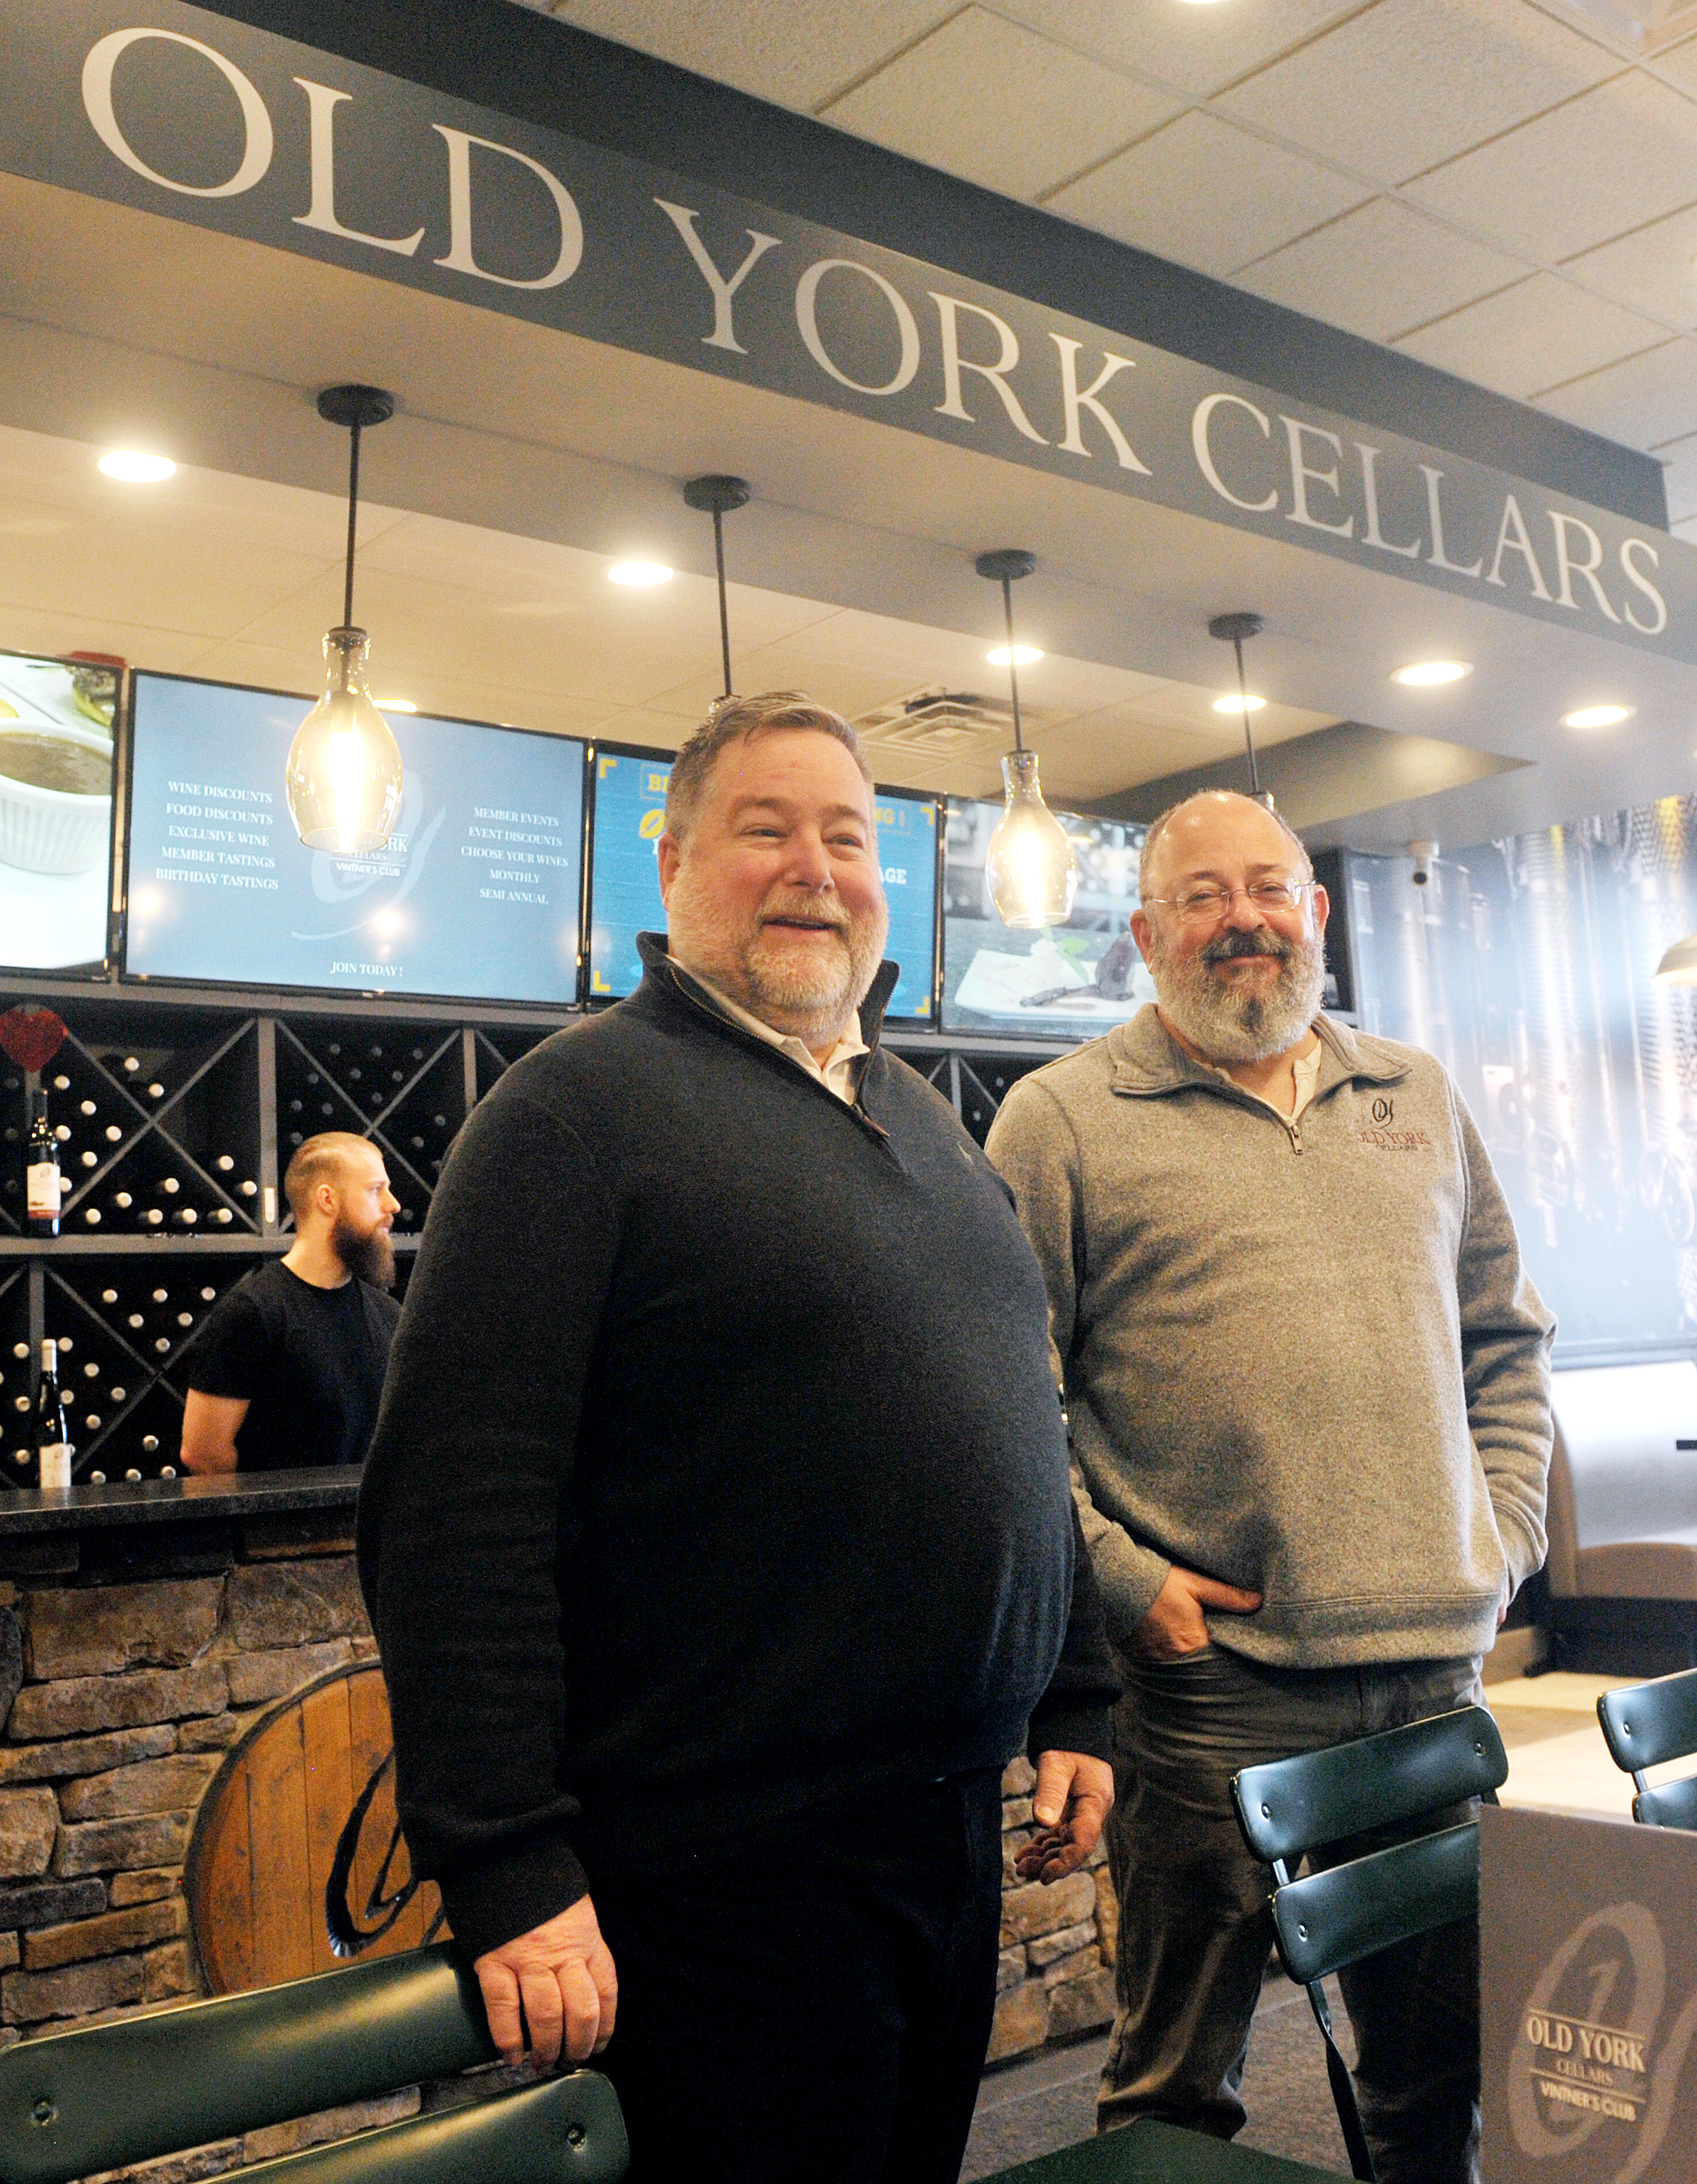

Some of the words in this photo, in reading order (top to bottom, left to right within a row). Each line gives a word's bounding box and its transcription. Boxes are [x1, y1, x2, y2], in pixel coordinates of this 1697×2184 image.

[81, 27, 584, 291] OLD
[652, 197, 1153, 477] YORK
[1191, 392, 1669, 635] CELLARS
[168, 780, 202, 795] WINE
[204, 785, 273, 804] DISCOUNTS
[166, 802, 202, 817] FOOD
[204, 807, 274, 825] DISCOUNTS
[474, 807, 518, 822] MEMBER
[520, 813, 559, 827] EVENTS
[168, 825, 235, 843] EXCLUSIVE
[238, 832, 270, 846] WINE
[469, 826, 504, 840] EVENT
[505, 831, 563, 846] DISCOUNTS
[161, 846, 215, 862] MEMBER
[217, 852, 276, 868] TASTINGS
[461, 846, 504, 860] CHOOSE
[506, 851, 535, 863] YOUR
[537, 854, 568, 867] WINES
[156, 868, 219, 884] BIRTHDAY
[221, 874, 279, 889] TASTINGS
[378, 867, 400, 877] CLUB
[489, 868, 541, 884] MONTHLY
[479, 888, 506, 900] SEMI
[507, 891, 549, 904] ANNUAL
[330, 962, 357, 974] JOIN
[1355, 1131, 1385, 1145] OLD
[1386, 1132, 1431, 1145] YORK
[1527, 2016, 1573, 2052] OLD
[1578, 2028, 1646, 2073] YORK
[1556, 2058, 1613, 2086] CELLARS
[1601, 2097, 1636, 2122] CLUB
